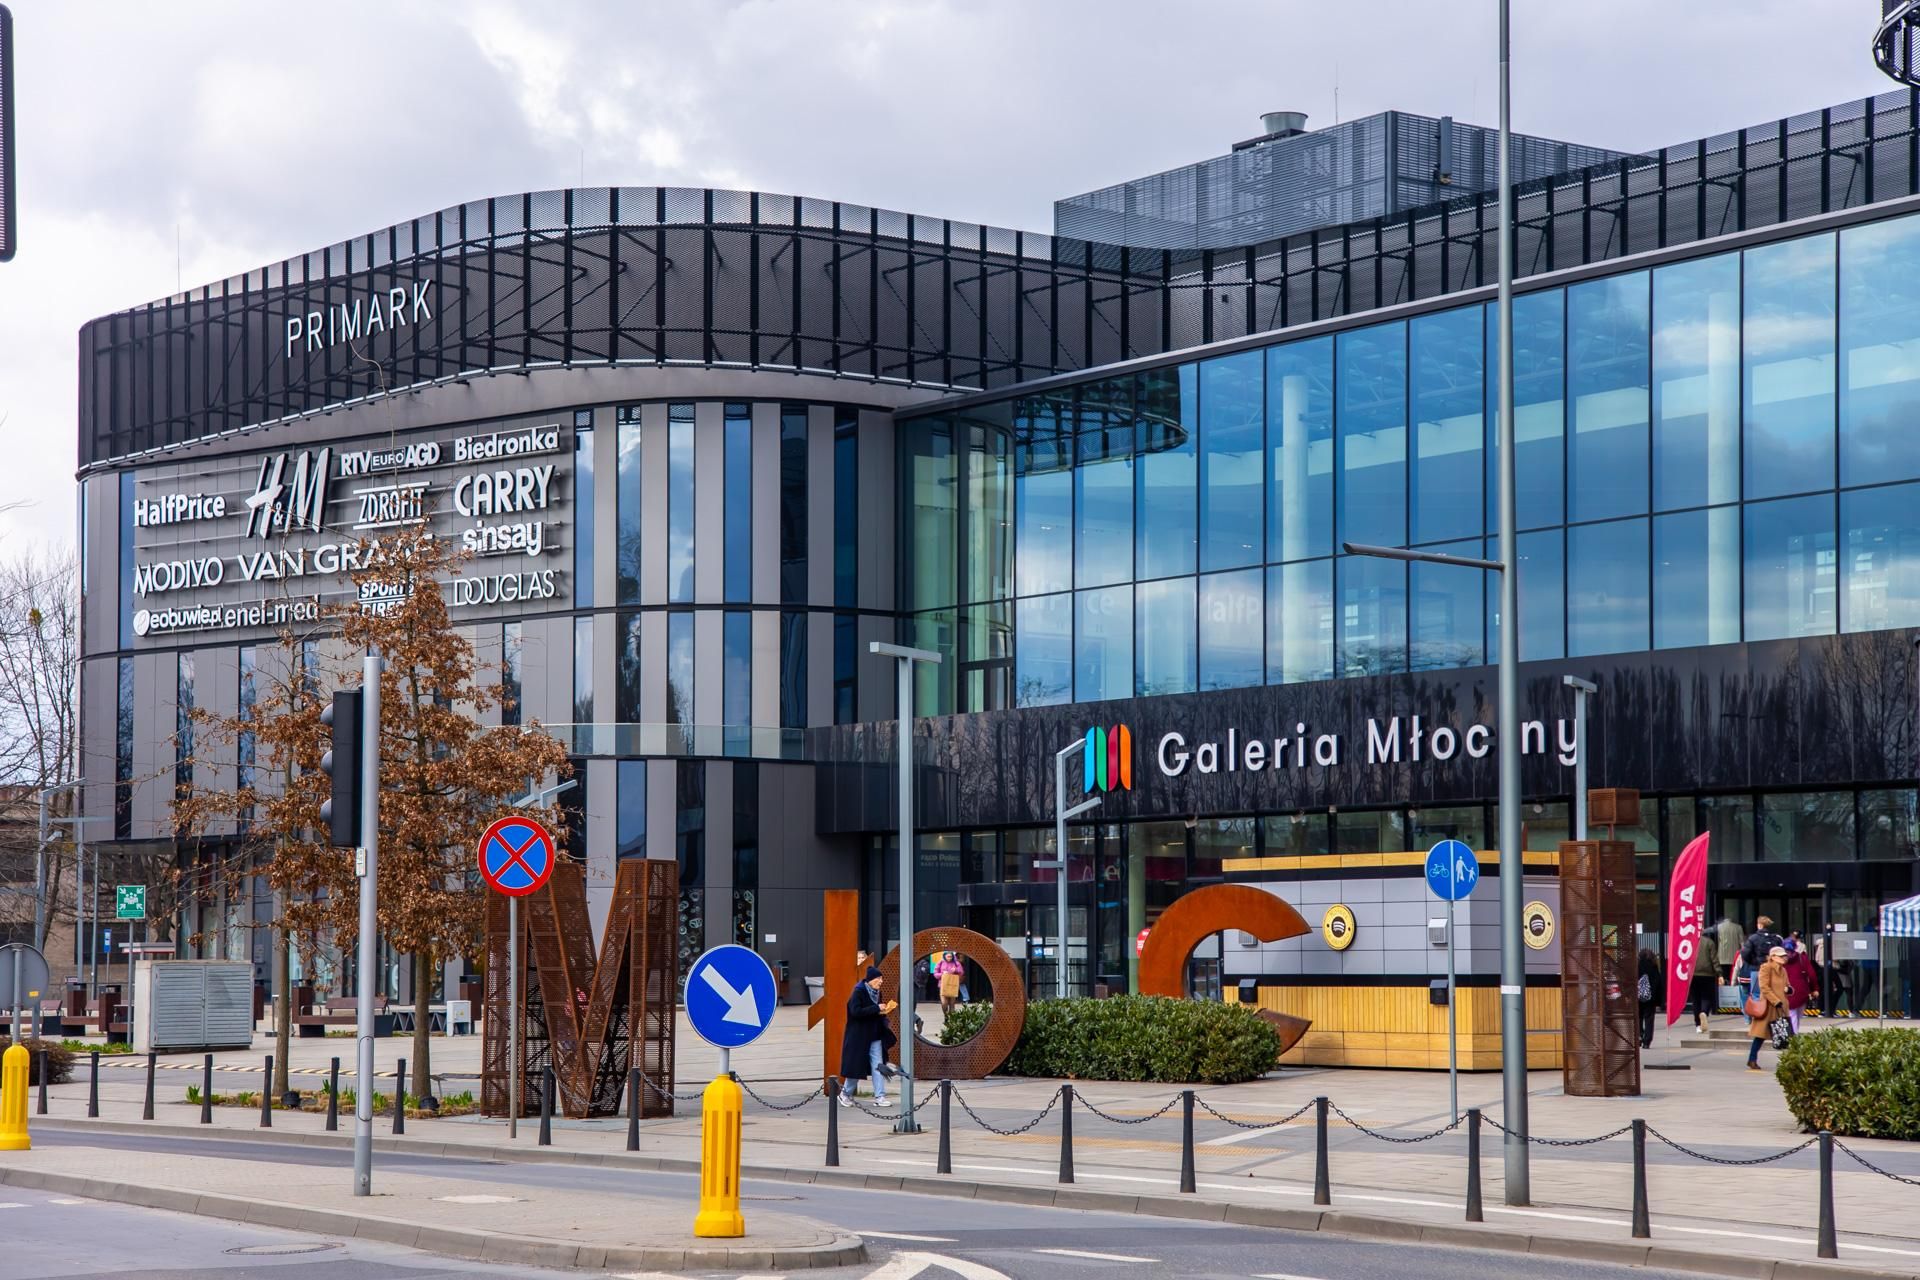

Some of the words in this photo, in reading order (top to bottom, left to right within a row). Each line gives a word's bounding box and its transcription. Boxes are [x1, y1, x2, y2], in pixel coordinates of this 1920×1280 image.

[287, 279, 431, 358] PRIMARK
[341, 450, 371, 476] RTV
[373, 452, 404, 466] EURO
[404, 442, 440, 467] AGD
[455, 427, 559, 461] Biedronka
[245, 447, 330, 539] H&M
[358, 488, 424, 523] ZDROFIT
[454, 465, 554, 517] CARRY
[134, 493, 226, 526] HalfPrice
[463, 520, 543, 556] sinsay
[134, 556, 224, 599] MODIVO
[237, 548, 304, 581] VAN
[454, 569, 556, 606] DOUGLAS
[150, 604, 222, 629] eobuwie.pl
[224, 594, 318, 628] enel-med
[1158, 722, 1339, 777] Galeria
[1367, 715, 1577, 767] Młocny
[1676, 884, 1696, 981] COSTA
